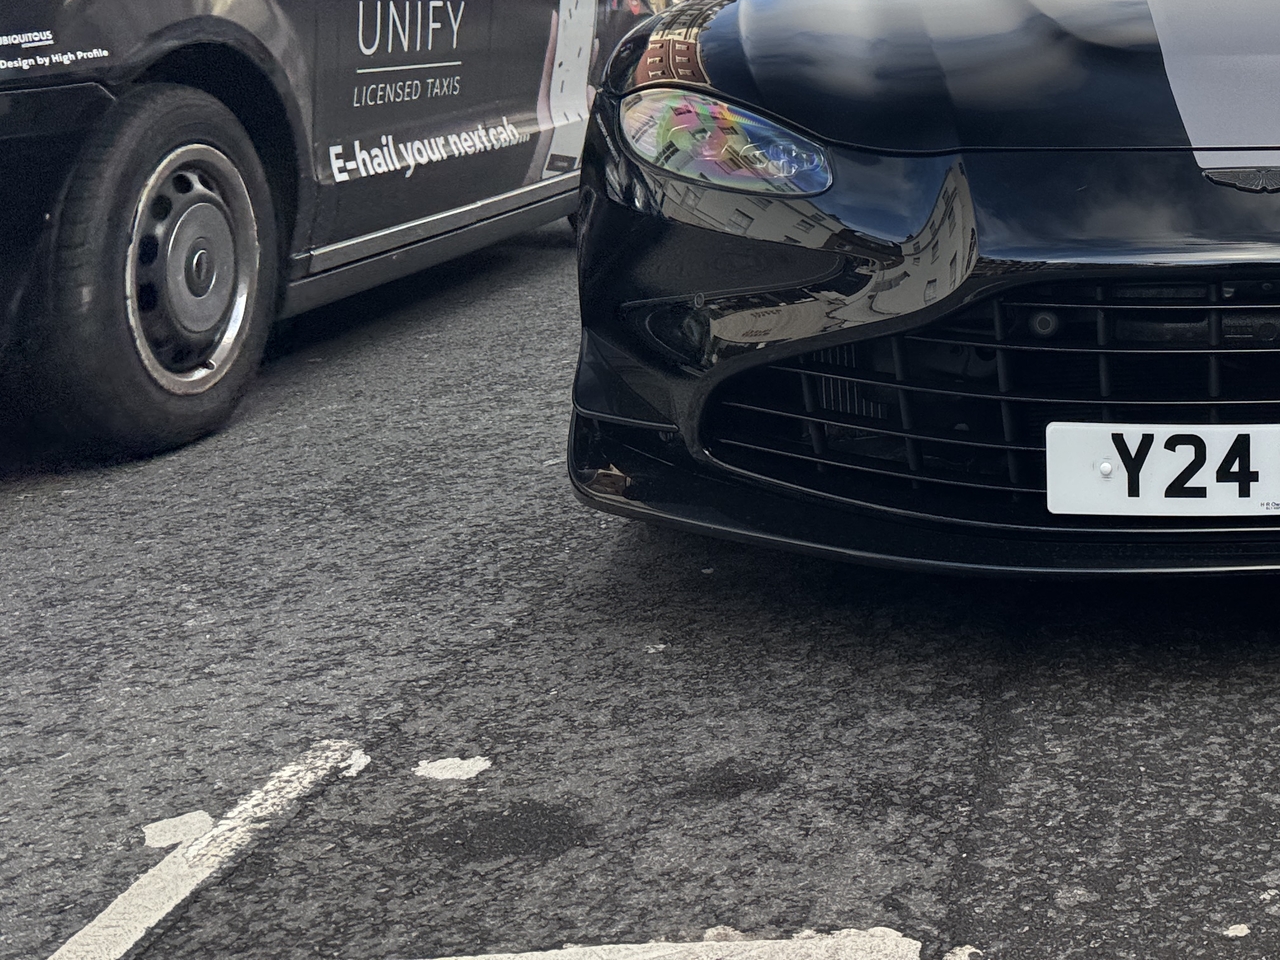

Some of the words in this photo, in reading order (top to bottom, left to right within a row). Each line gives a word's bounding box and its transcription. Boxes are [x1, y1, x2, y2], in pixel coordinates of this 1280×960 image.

[358, 0, 465, 56] UNIFY
[0, 58, 35, 70] Design
[36, 55, 50, 66] by
[51, 52, 76, 64] High
[76, 48, 109, 60] Profile
[353, 80, 421, 107] LICENSED
[427, 76, 461, 99] TAXIS
[329, 135, 401, 183] E-hail
[398, 135, 448, 178] your
[447, 124, 490, 158] next
[1111, 432, 1259, 499] Y24
